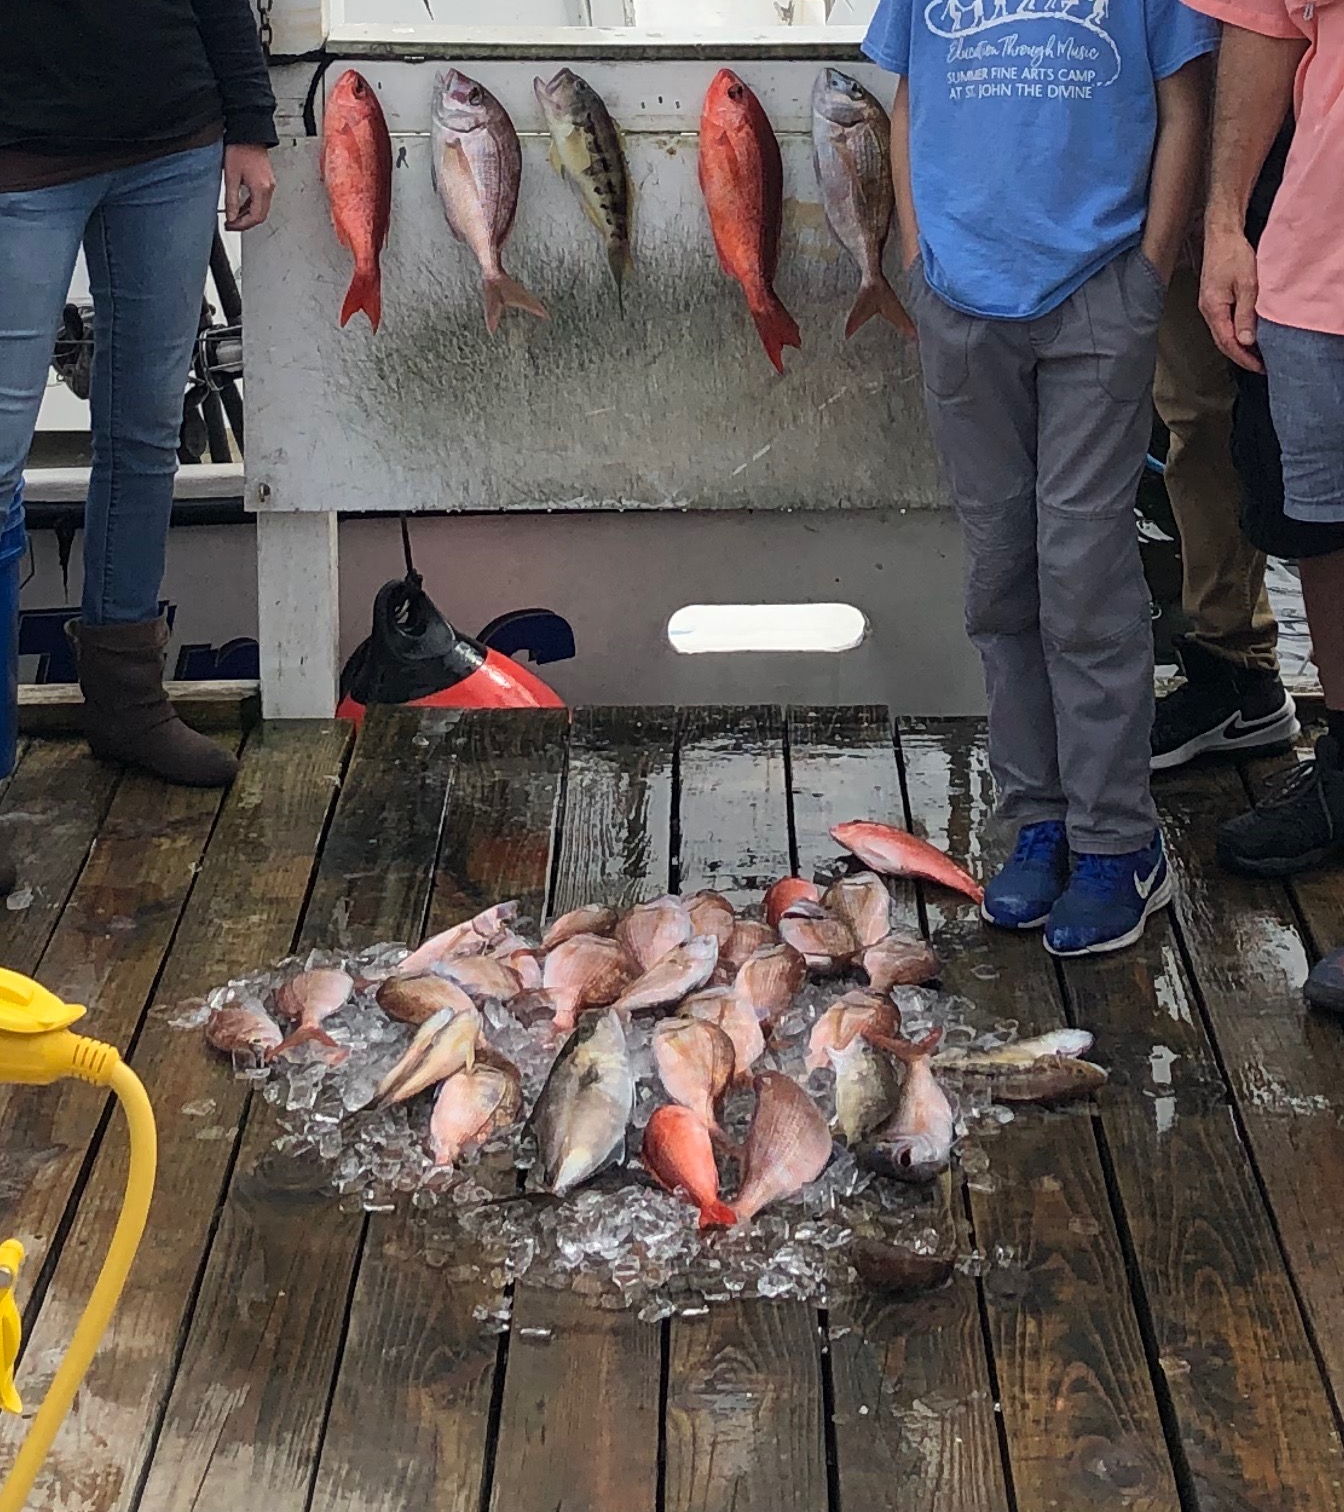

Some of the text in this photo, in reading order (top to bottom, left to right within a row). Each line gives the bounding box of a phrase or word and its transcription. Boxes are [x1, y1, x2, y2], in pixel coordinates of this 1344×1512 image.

[946, 33, 1100, 69] Education Through Music
[990, 67, 1018, 80] FINE
[1021, 68, 1055, 81] ARTS
[1058, 68, 1096, 82] CAMP
[949, 86, 962, 99] AT
[978, 83, 1011, 99] JOHN
[1015, 83, 1043, 97] THE
[1047, 84, 1092, 99] DIVINE
